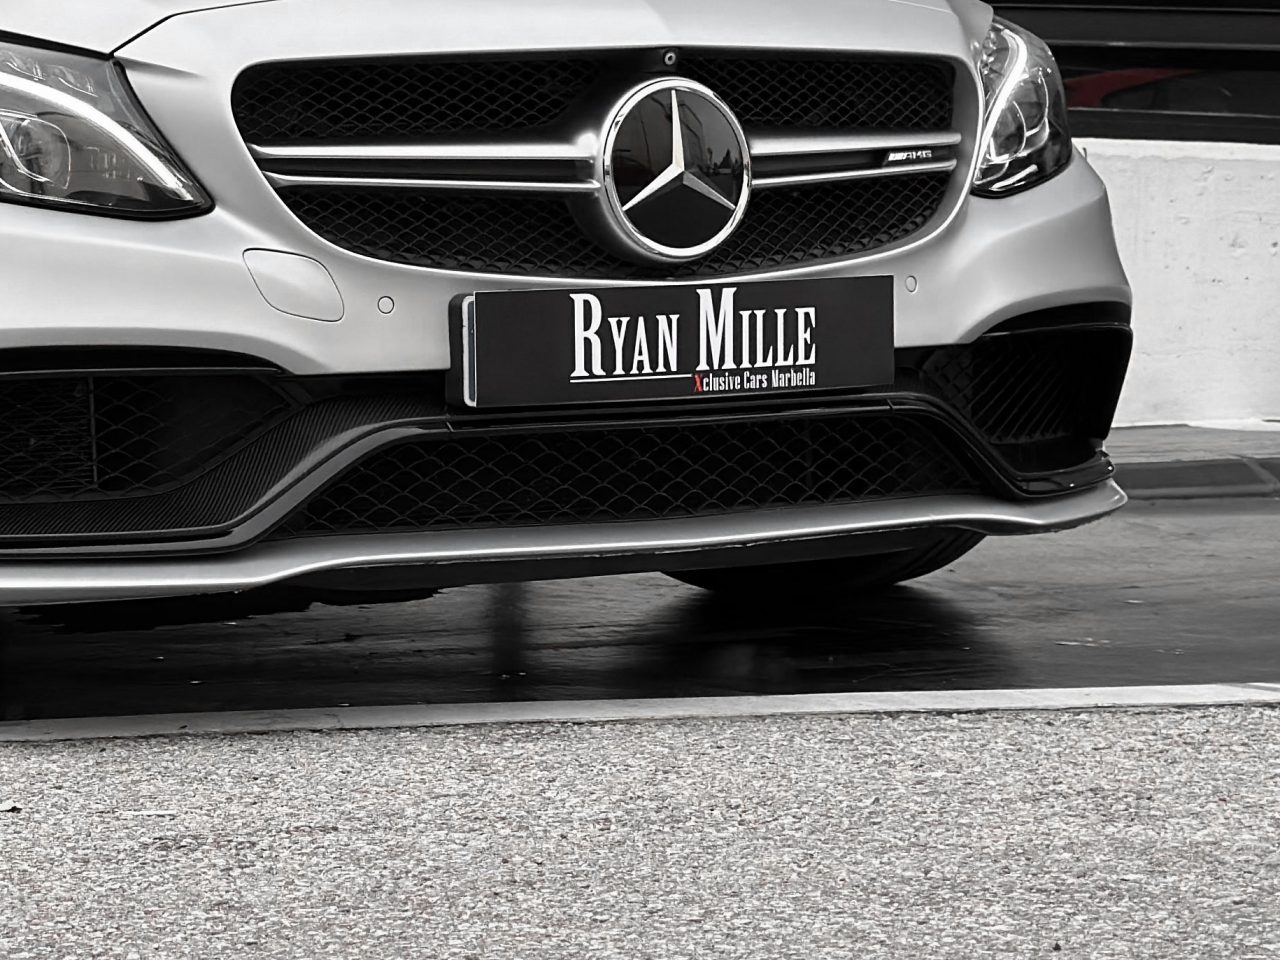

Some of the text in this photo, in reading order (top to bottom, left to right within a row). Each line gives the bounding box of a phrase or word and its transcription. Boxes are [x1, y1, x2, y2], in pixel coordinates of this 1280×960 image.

[570, 287, 816, 377] RYAN MILLE
[694, 367, 816, 393] Xclusive Cars Marbella
